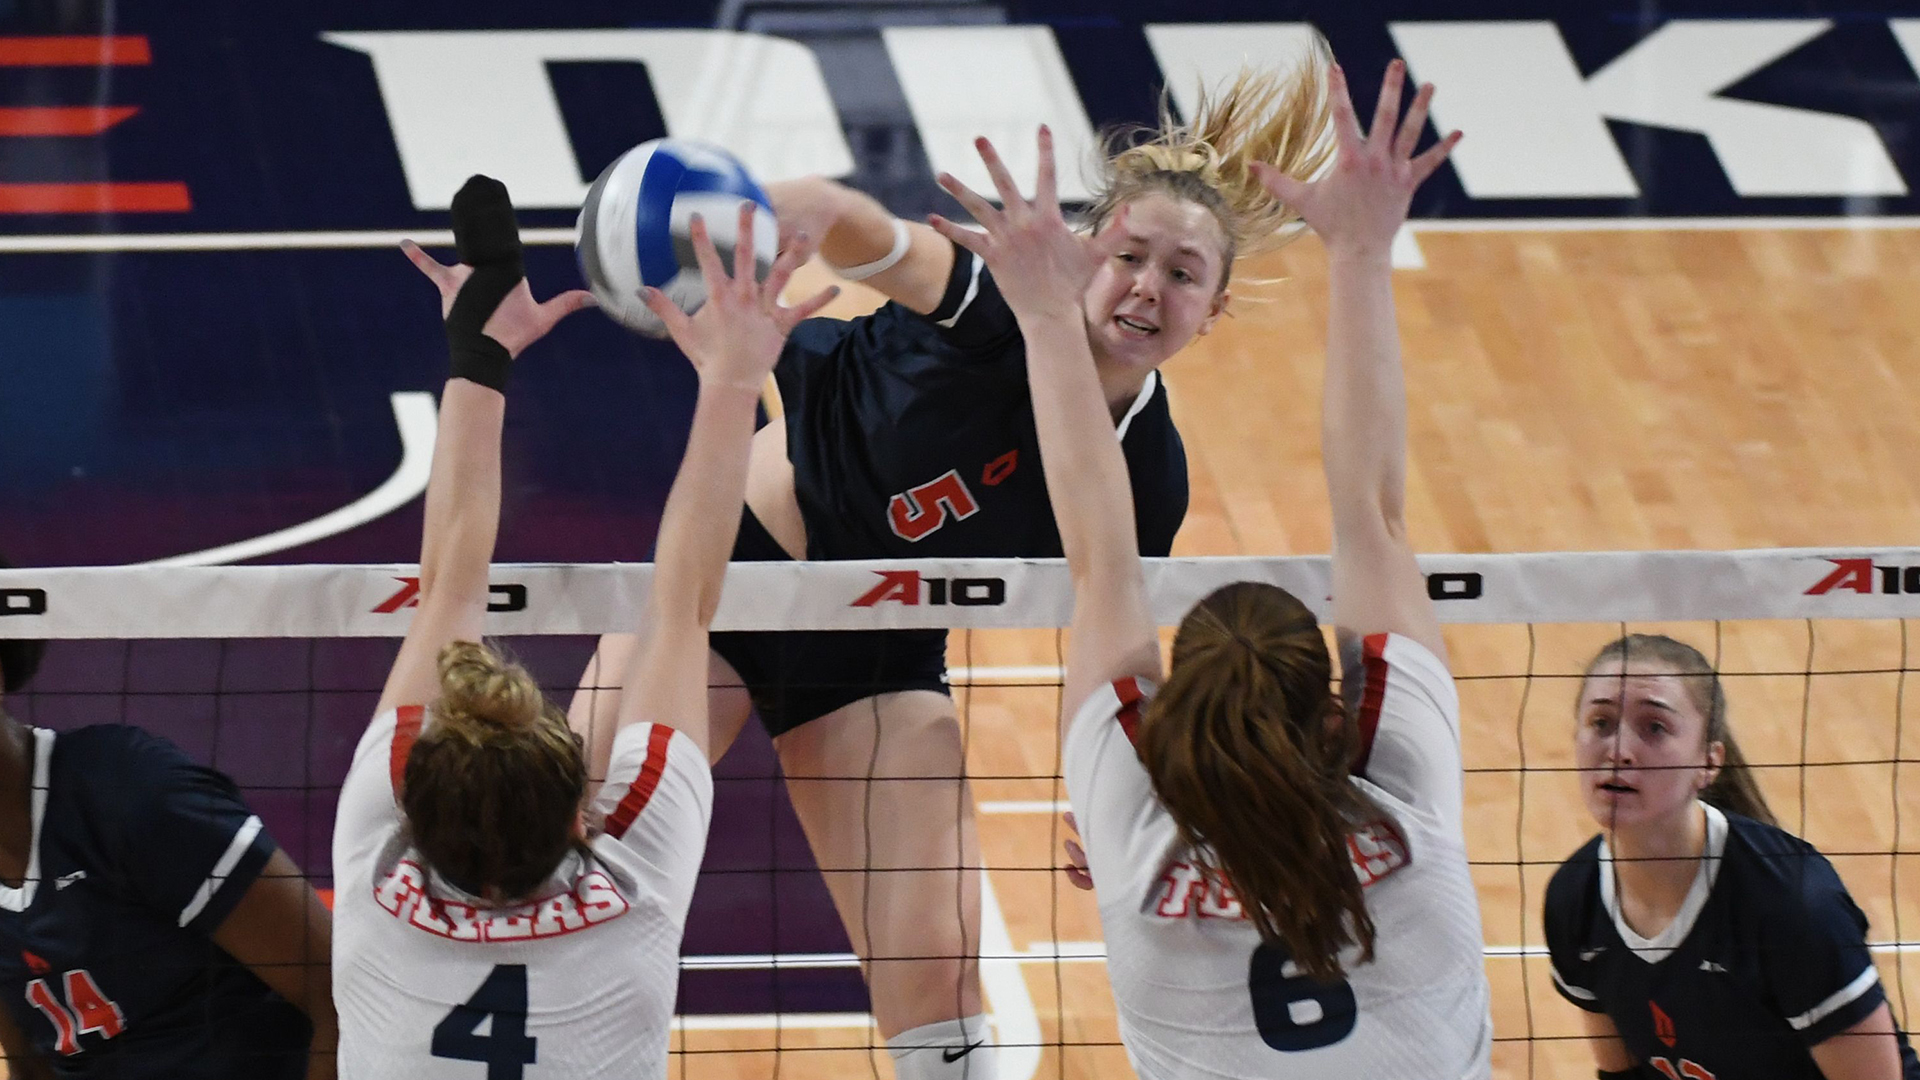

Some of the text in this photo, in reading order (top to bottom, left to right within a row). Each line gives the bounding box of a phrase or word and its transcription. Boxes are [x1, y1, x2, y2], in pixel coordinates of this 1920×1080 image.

[322, 17, 1920, 212] DUK
[887, 461, 980, 542] 5
[849, 570, 1006, 607] A10
[374, 860, 630, 943] FLYERS
[25, 969, 127, 1056] 14
[431, 964, 537, 1080] 4
[1249, 940, 1357, 1052] 6
